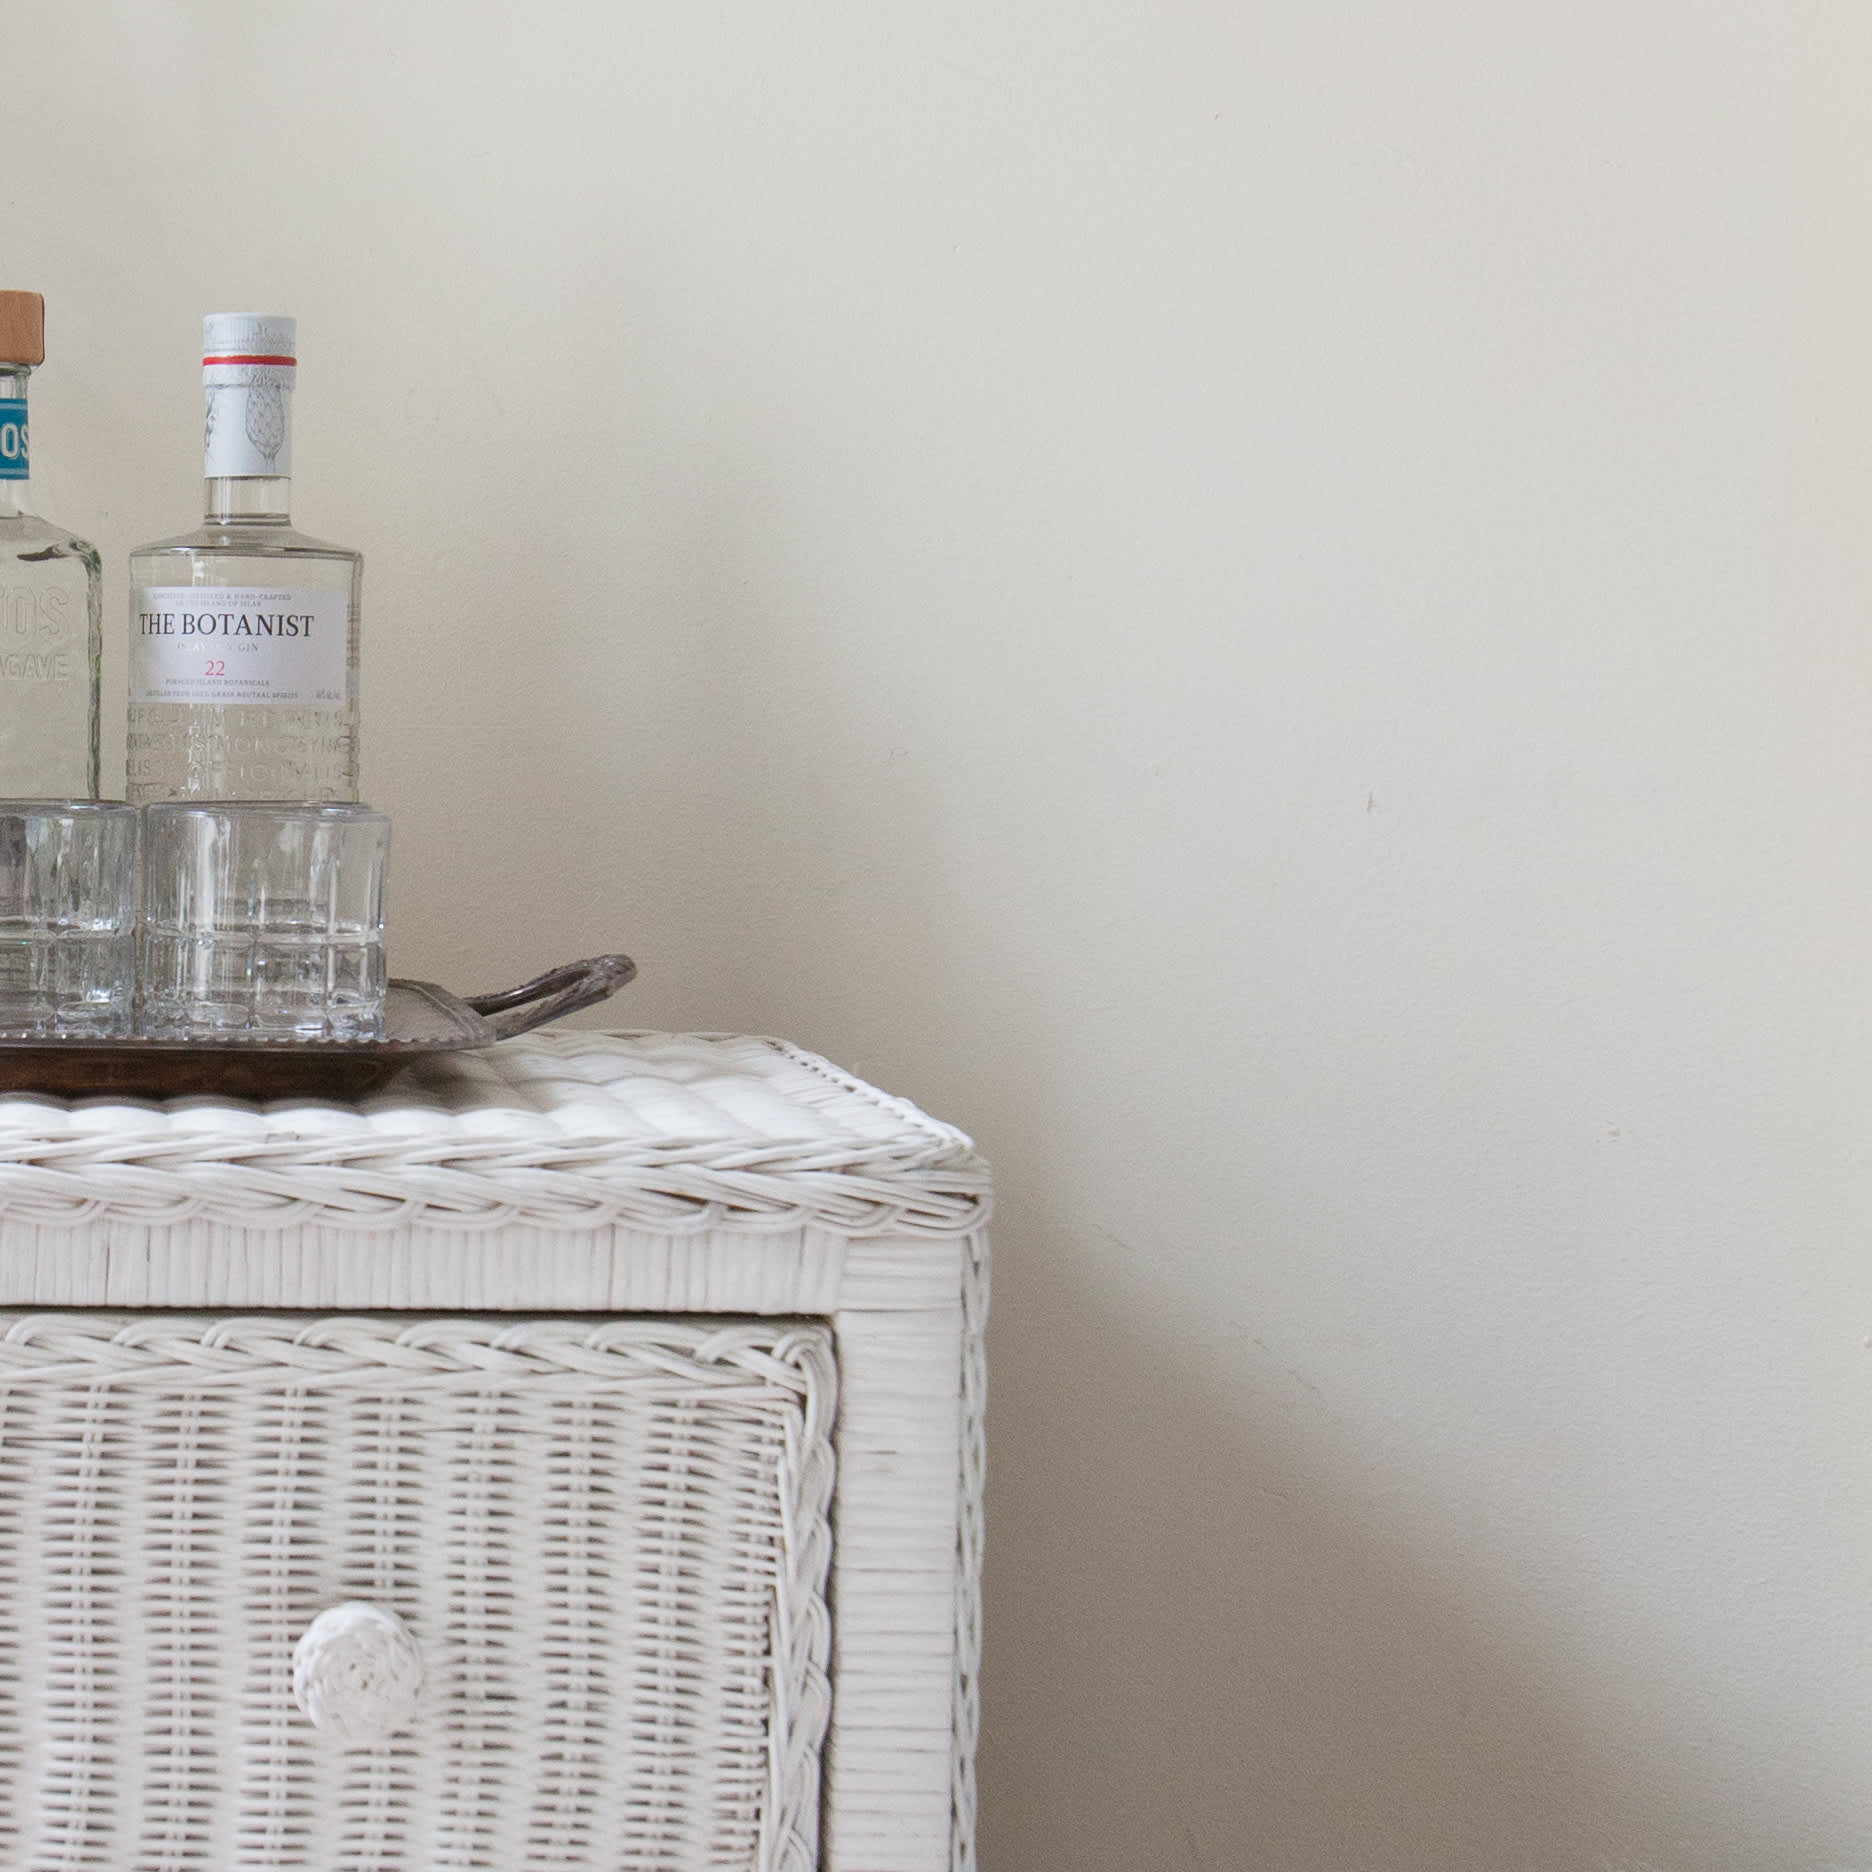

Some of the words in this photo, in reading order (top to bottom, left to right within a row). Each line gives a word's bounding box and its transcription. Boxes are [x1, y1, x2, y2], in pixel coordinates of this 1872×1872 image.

[139, 613, 175, 636] THE
[181, 613, 315, 638] BOTANIST
[205, 660, 225, 676] 22
